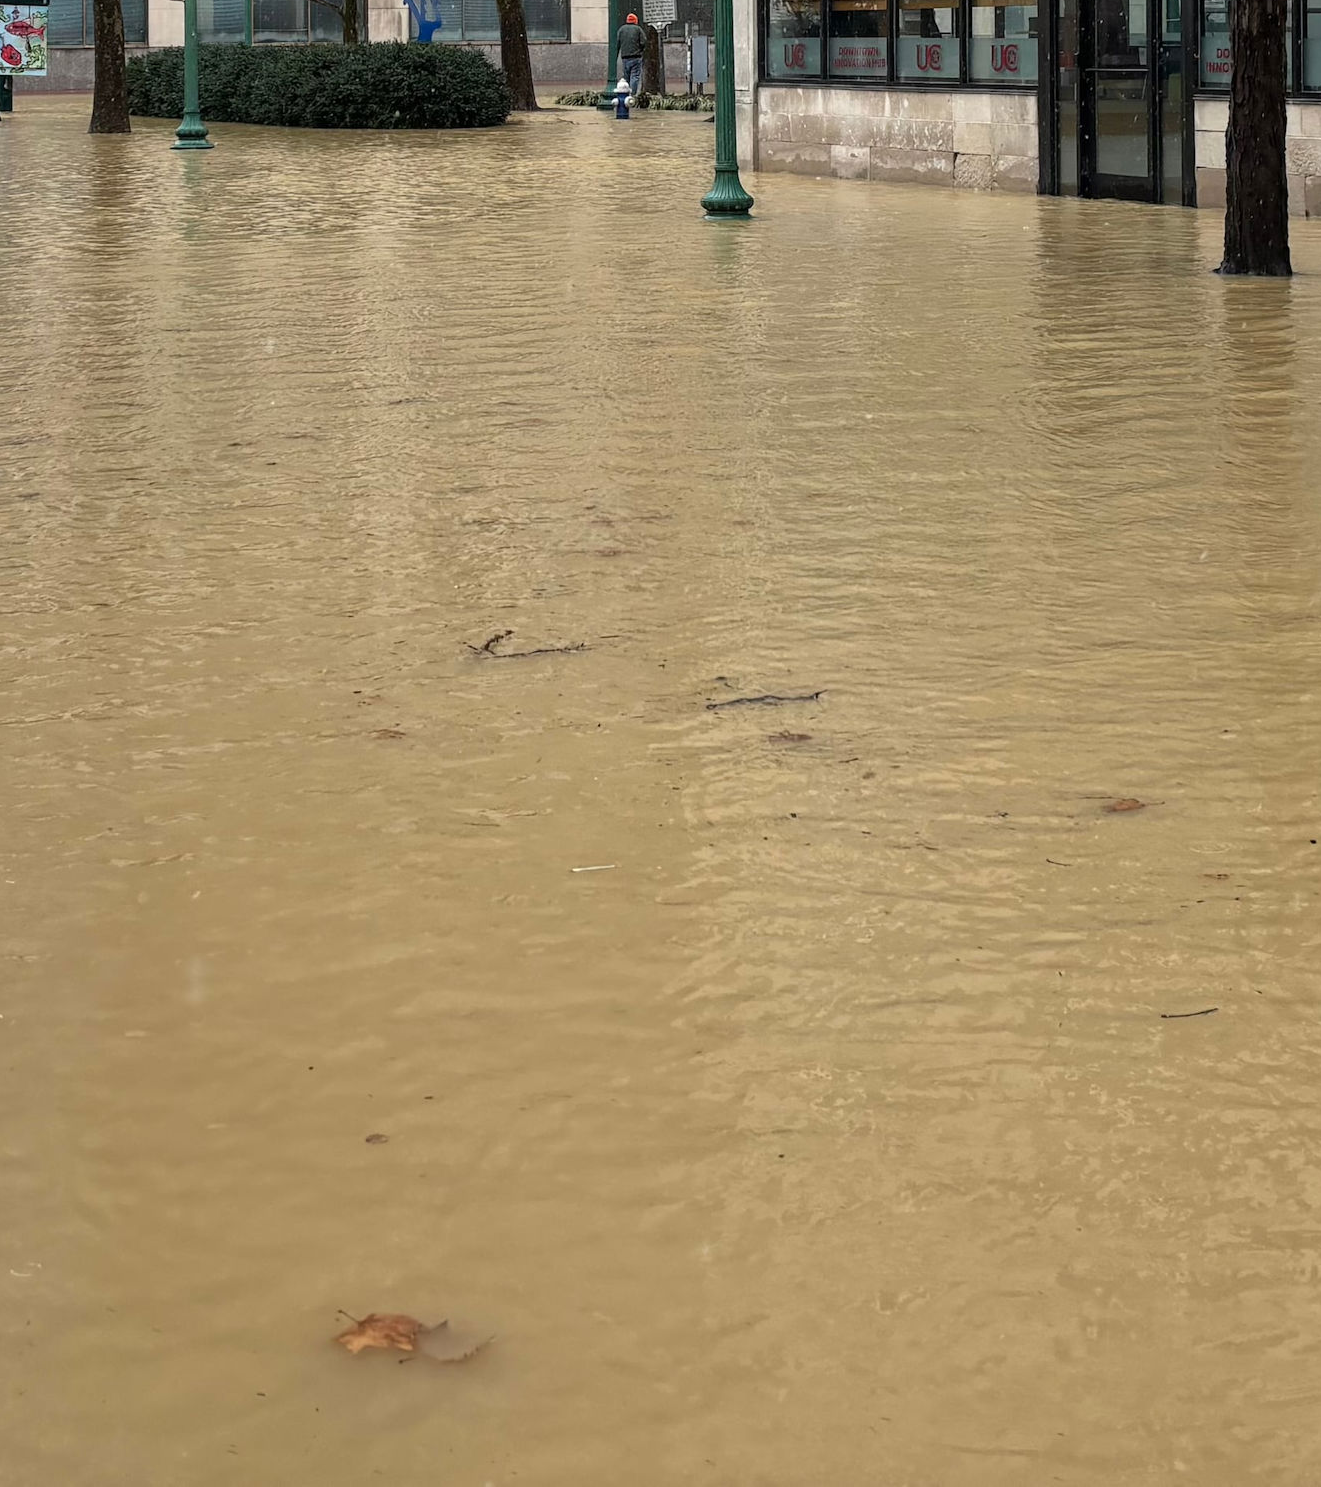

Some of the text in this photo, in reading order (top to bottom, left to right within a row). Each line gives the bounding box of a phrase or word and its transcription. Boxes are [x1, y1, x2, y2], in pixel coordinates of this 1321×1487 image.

[784, 43, 806, 69] UC
[916, 44, 942, 72] UC
[991, 44, 1019, 73] UC
[1216, 48, 1230, 59] DO
